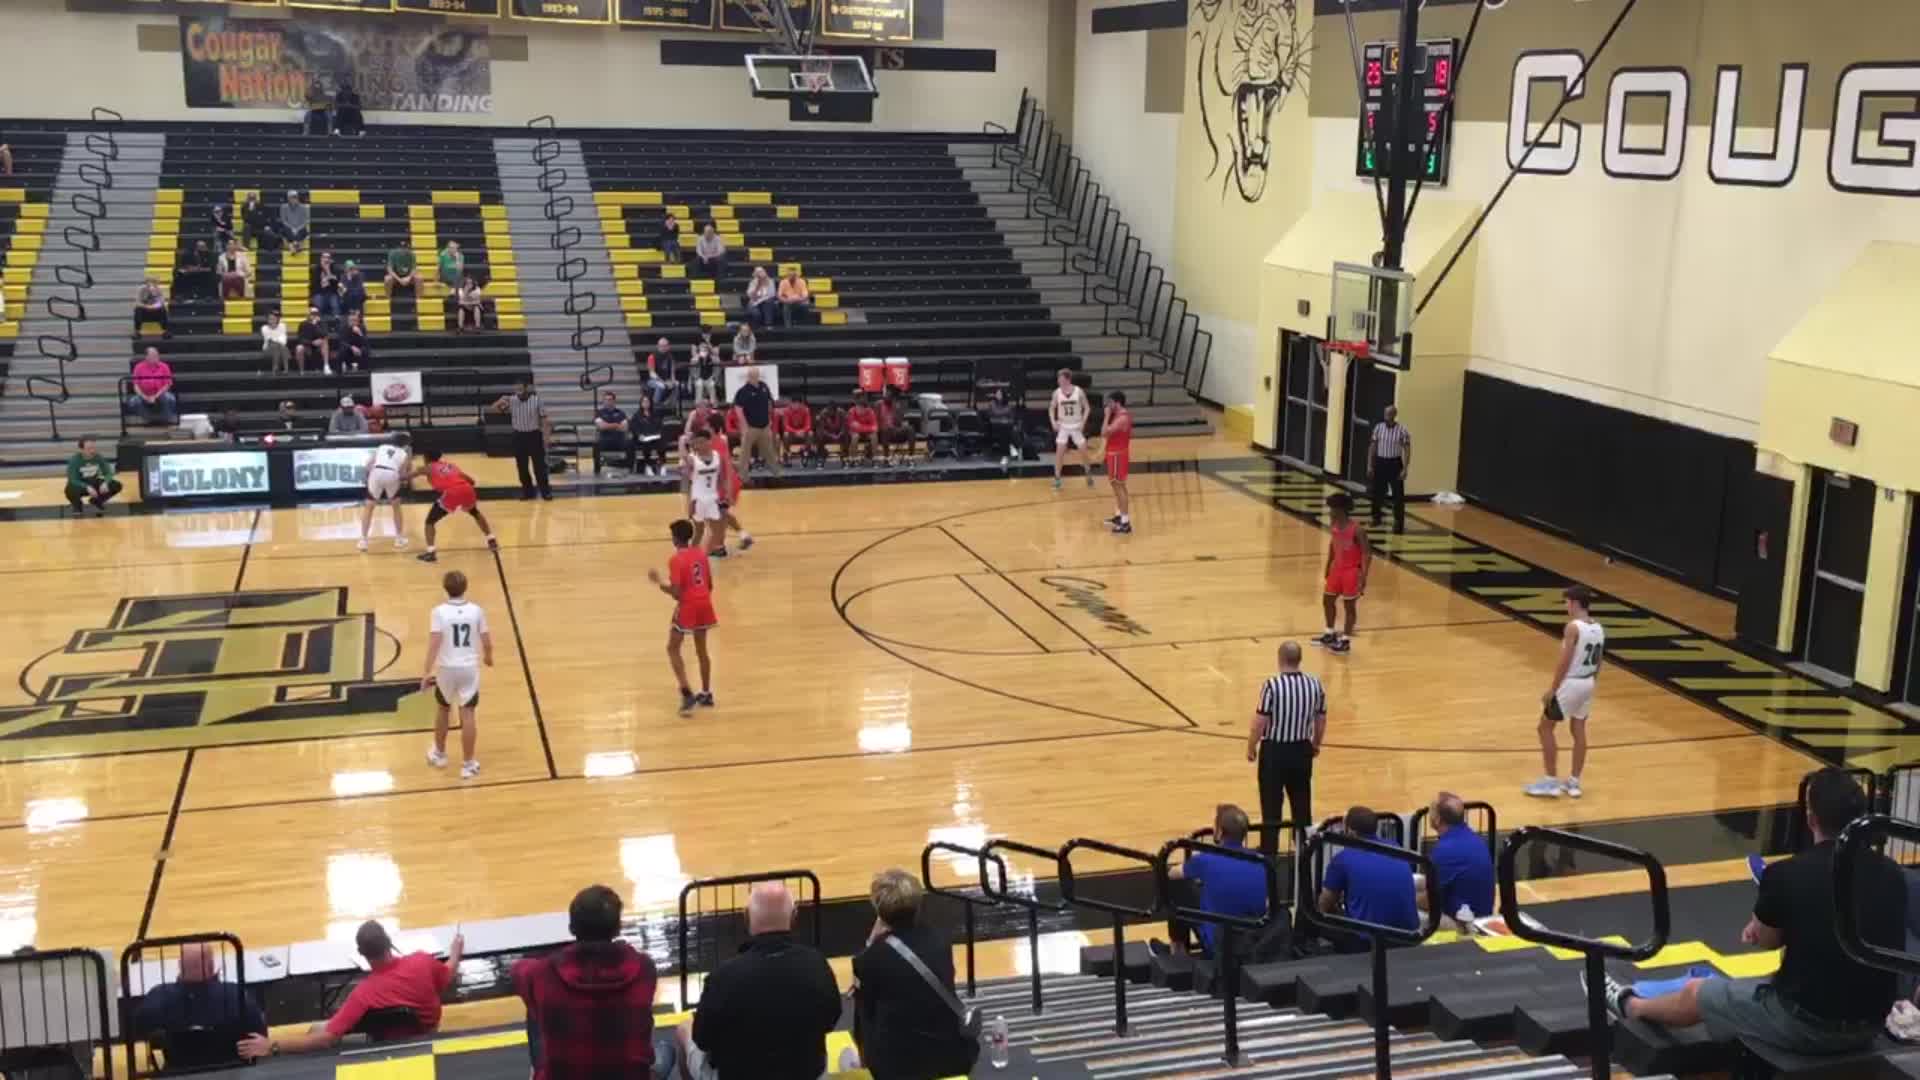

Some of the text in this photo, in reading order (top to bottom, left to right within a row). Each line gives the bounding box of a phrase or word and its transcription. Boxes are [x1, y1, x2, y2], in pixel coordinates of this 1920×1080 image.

[186, 22, 284, 69] Cougar
[218, 65, 306, 102] Nation
[162, 466, 265, 492] COLONY
[451, 623, 471, 648] 12
